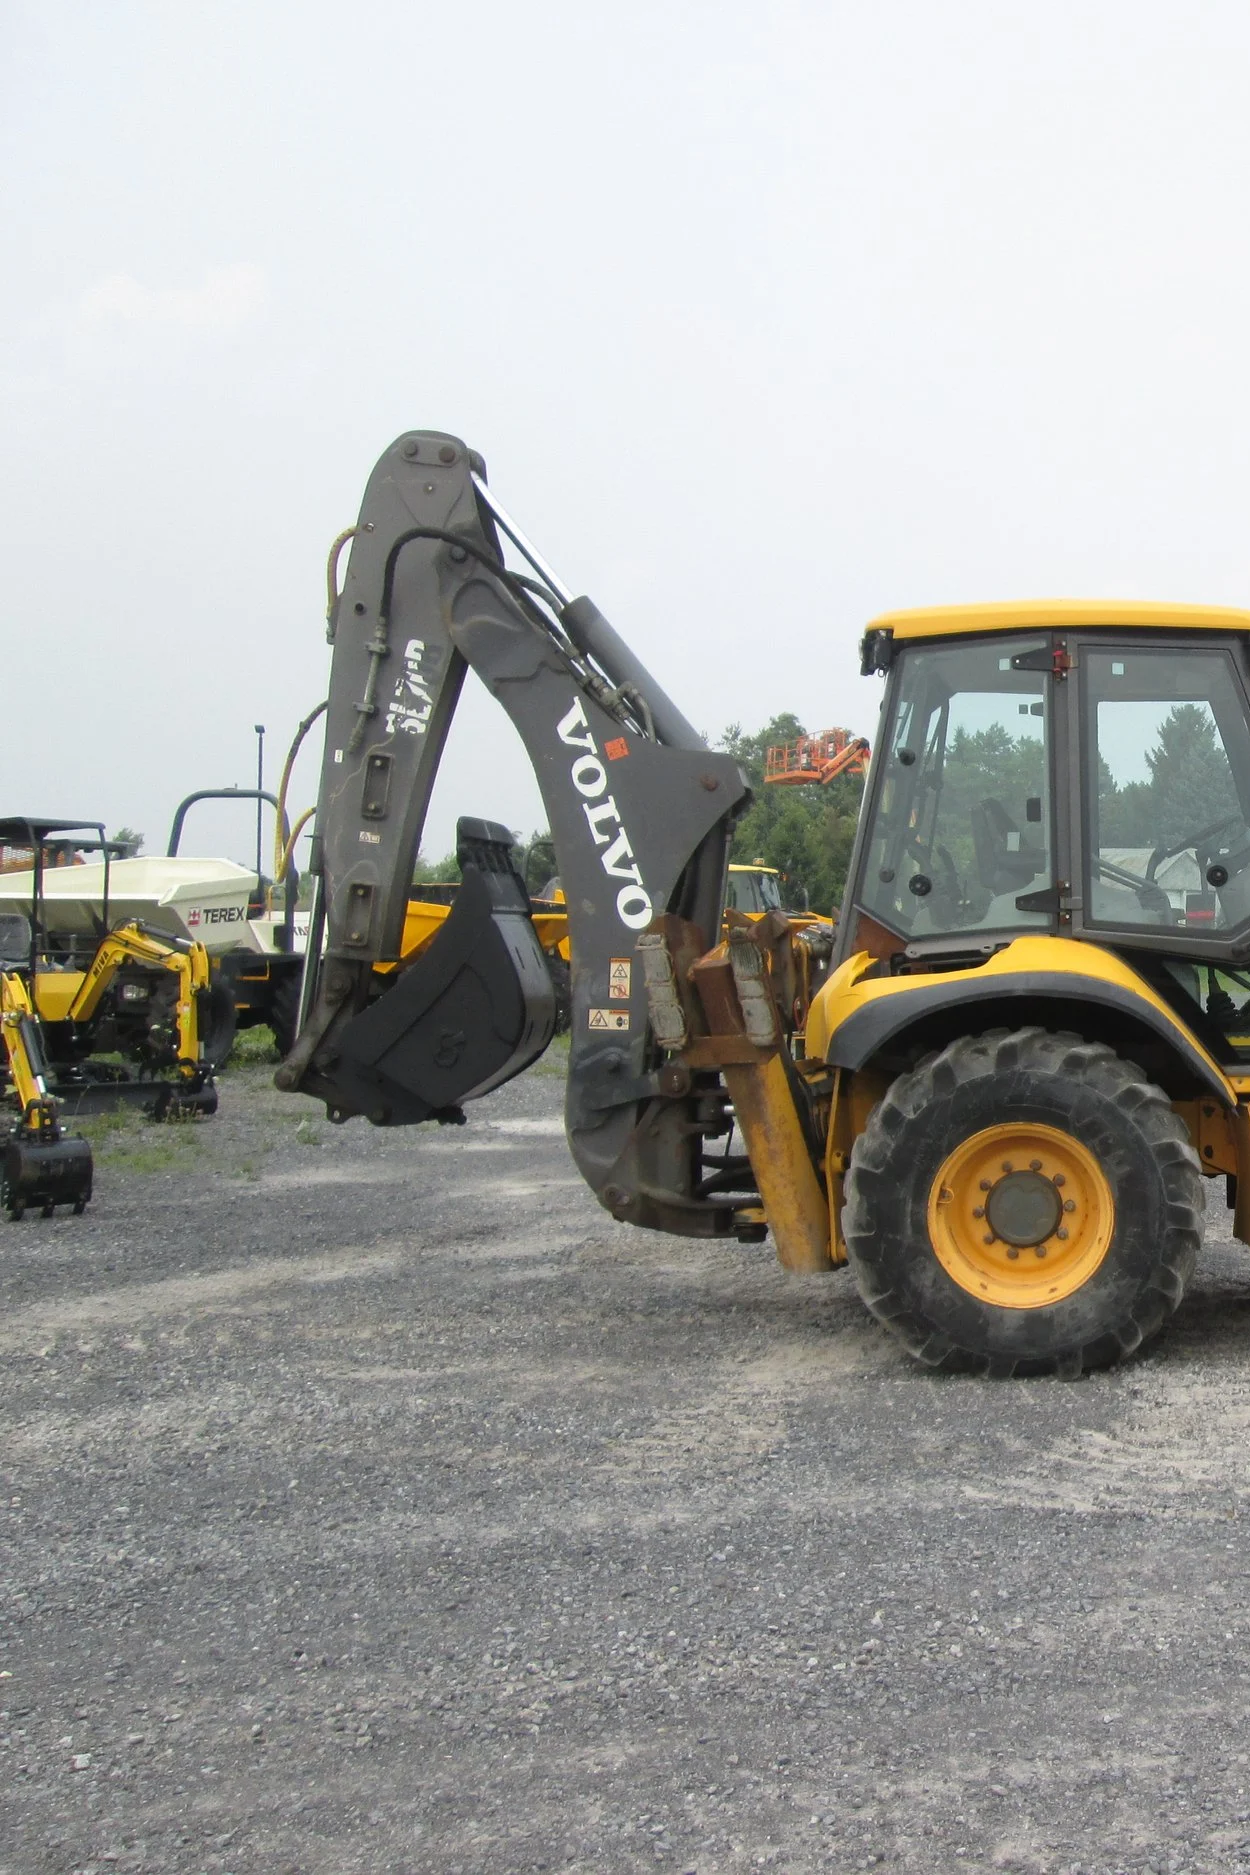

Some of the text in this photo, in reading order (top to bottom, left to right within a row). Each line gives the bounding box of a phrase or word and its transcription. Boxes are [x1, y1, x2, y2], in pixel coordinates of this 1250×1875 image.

[556, 696, 653, 930] VOLVO
[203, 907, 245, 924] TEREX
[93, 951, 109, 978] MIVA
